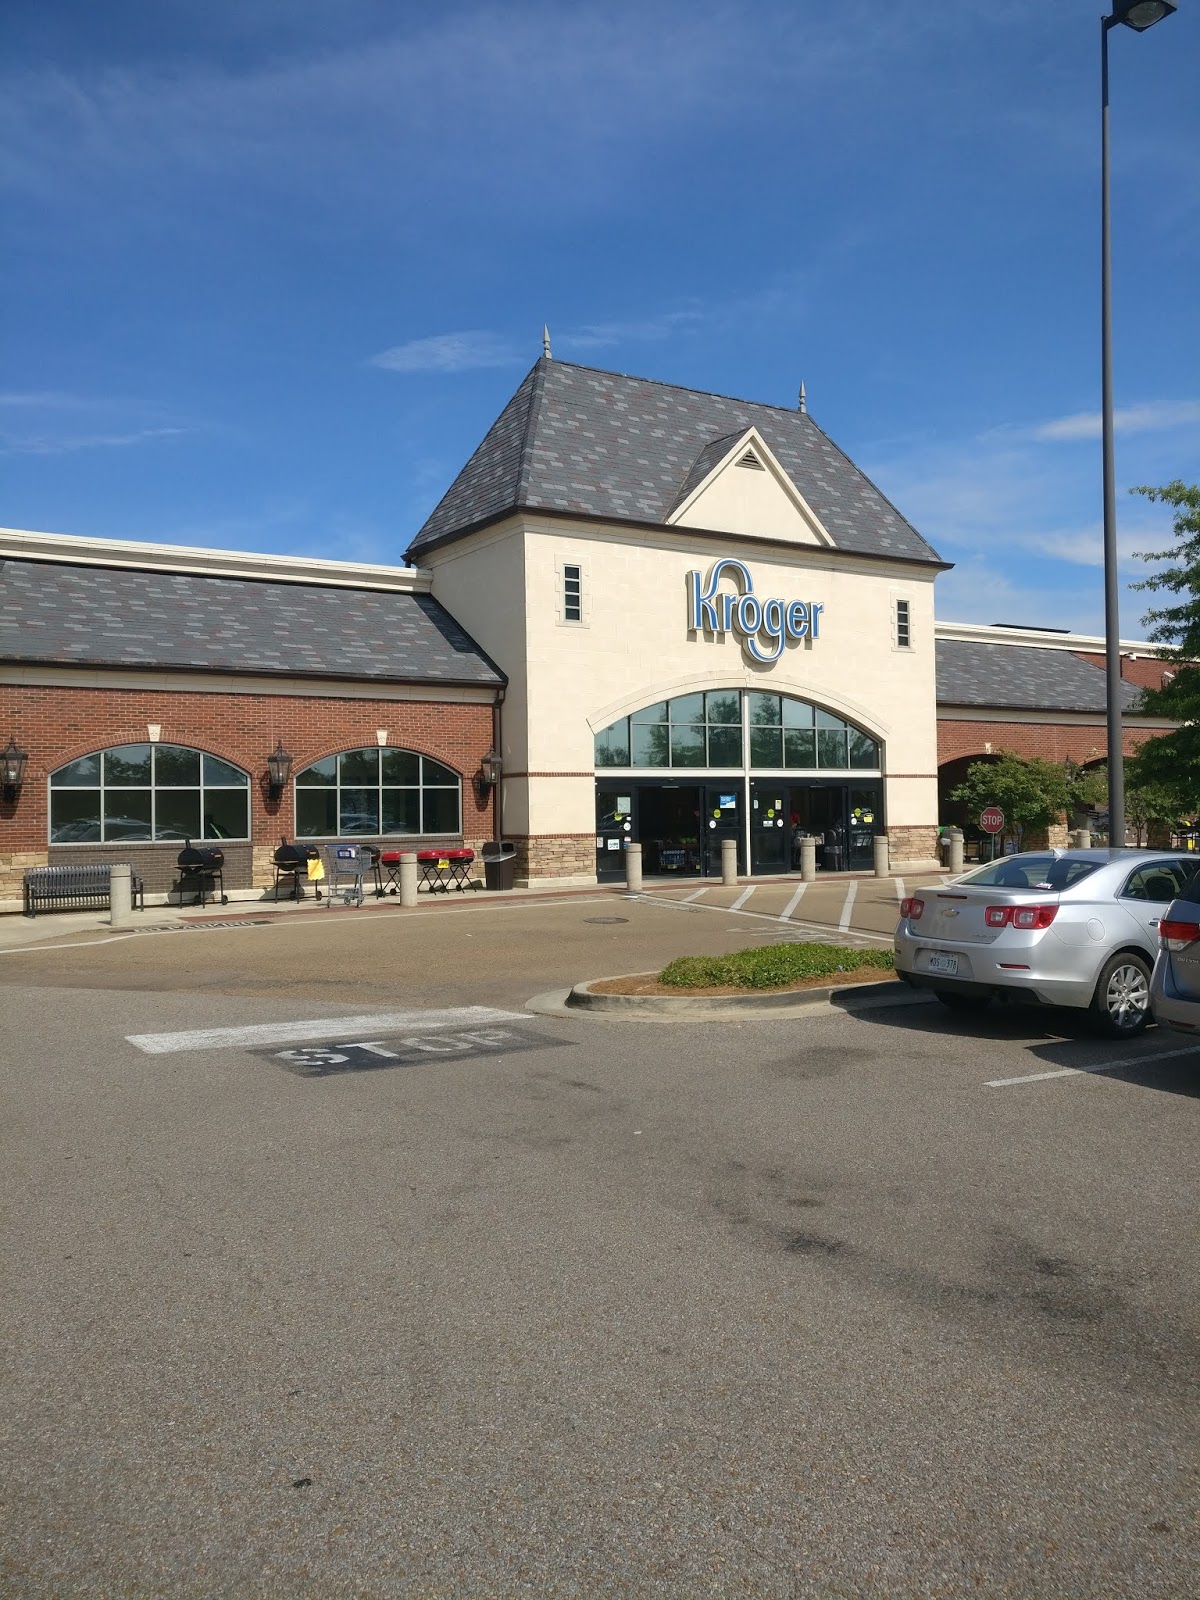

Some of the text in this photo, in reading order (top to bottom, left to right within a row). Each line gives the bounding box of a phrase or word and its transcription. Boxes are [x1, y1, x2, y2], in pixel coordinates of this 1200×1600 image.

[687, 558, 824, 663] Kroger
[982, 815, 1003, 825] STOP
[946, 959, 957, 969] 378
[274, 1029, 512, 1065] STOP
